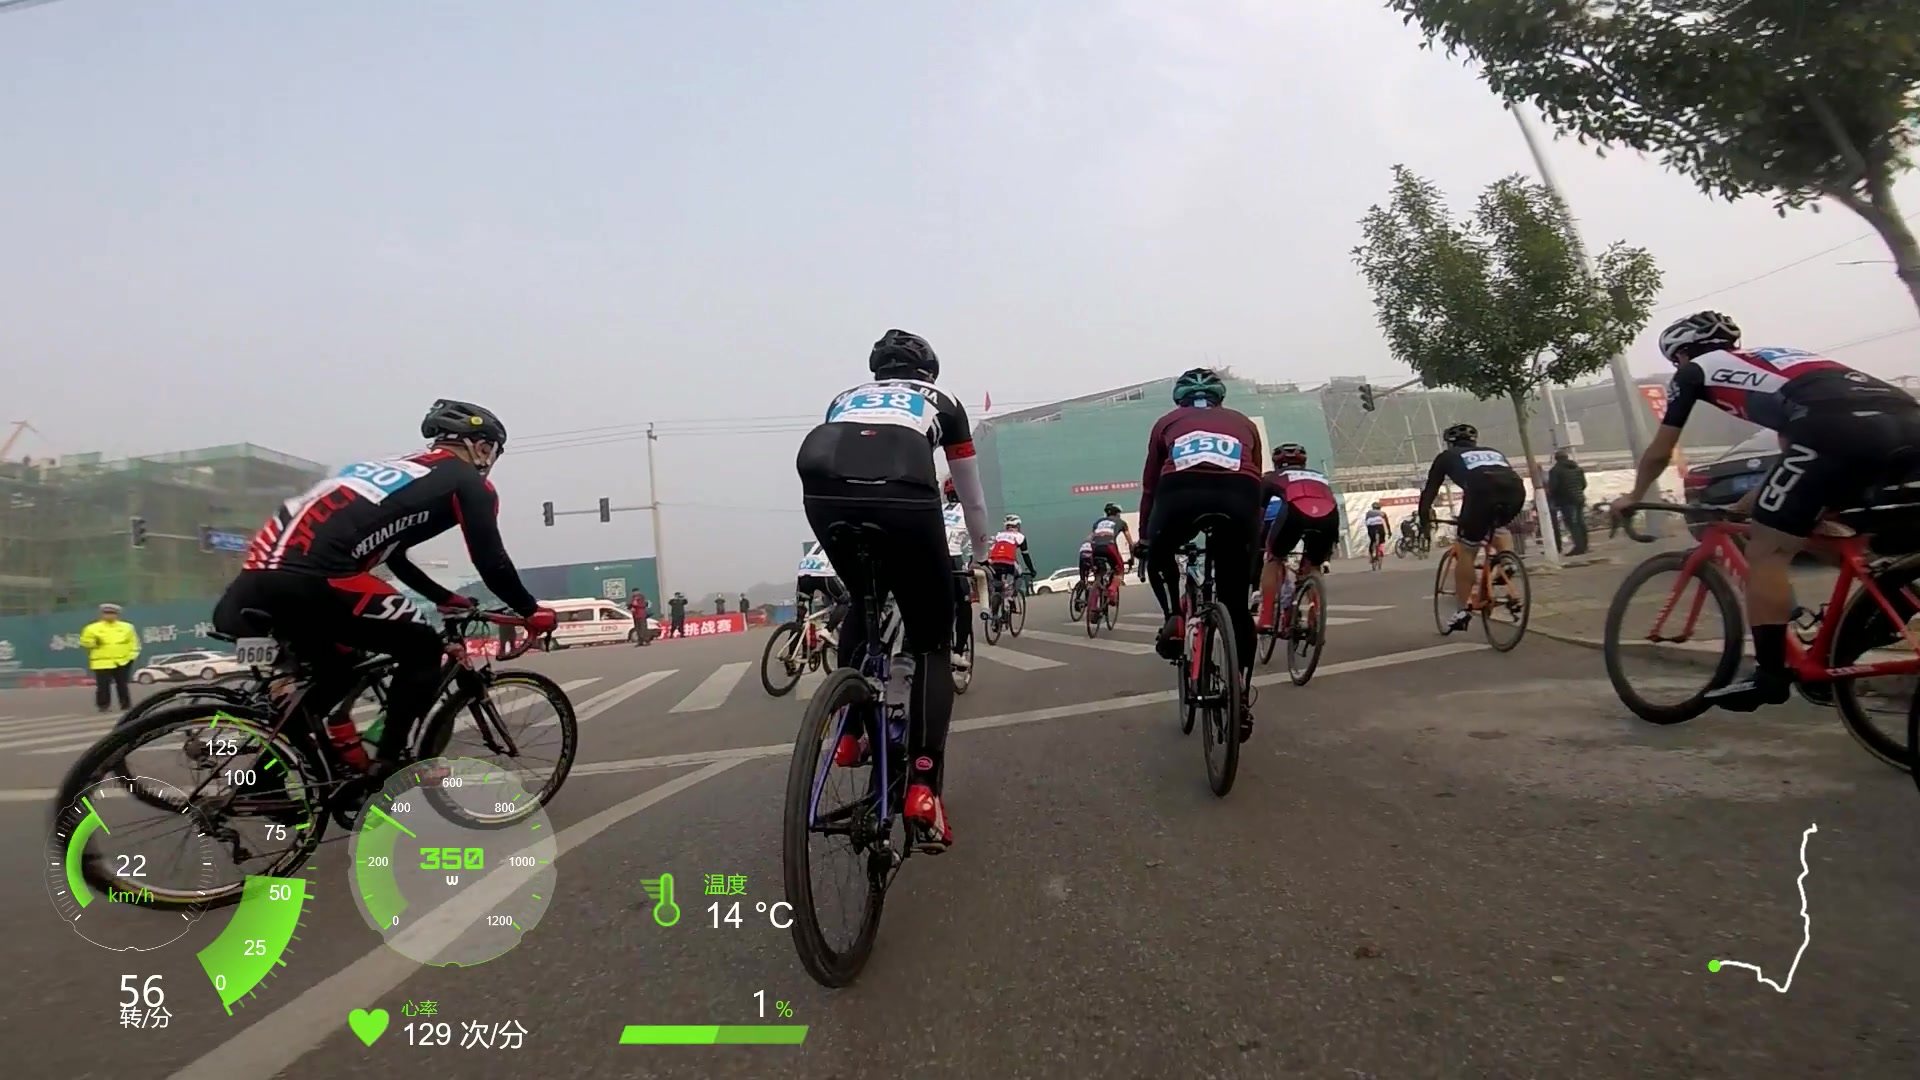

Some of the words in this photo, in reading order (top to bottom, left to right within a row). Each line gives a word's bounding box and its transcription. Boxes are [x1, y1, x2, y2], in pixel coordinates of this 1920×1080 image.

[1711, 368, 1768, 387] GCN
[1179, 437, 1235, 456] 150
[1758, 444, 1819, 513] GCN
[237, 645, 274, 664] 0606
